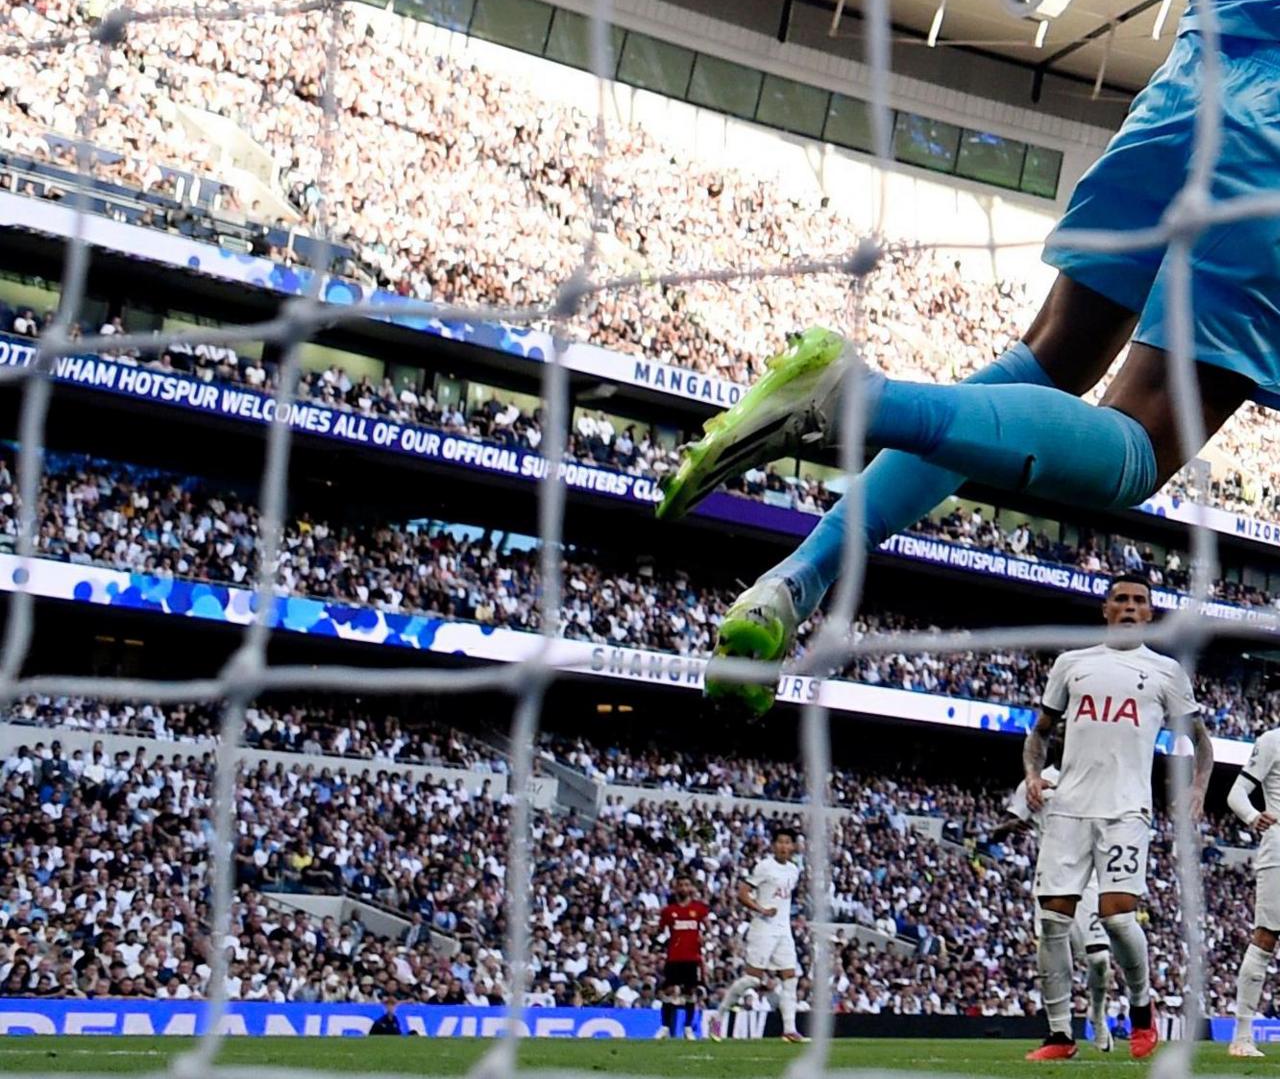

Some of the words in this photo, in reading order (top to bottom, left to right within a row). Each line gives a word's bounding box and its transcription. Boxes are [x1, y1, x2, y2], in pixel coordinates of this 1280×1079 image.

[634, 361, 748, 406] MANGALO
[0, 340, 116, 388] OTTNHAM
[118, 369, 219, 410] HOTSPUR
[221, 389, 331, 433] WELCOMES
[333, 414, 368, 441] ALL
[372, 423, 400, 447] OF
[401, 428, 441, 456] OUR
[442, 437, 519, 473] OFFICIAL
[950, 547, 1007, 576] HOTSPUR
[1007, 558, 1071, 589] WELCOMES
[1071, 575, 1091, 593] ALL
[1093, 578, 1109, 595] OF
[591, 647, 700, 685] SHANGH
[1074, 694, 1140, 727] AIA
[1106, 844, 1140, 875] 23
